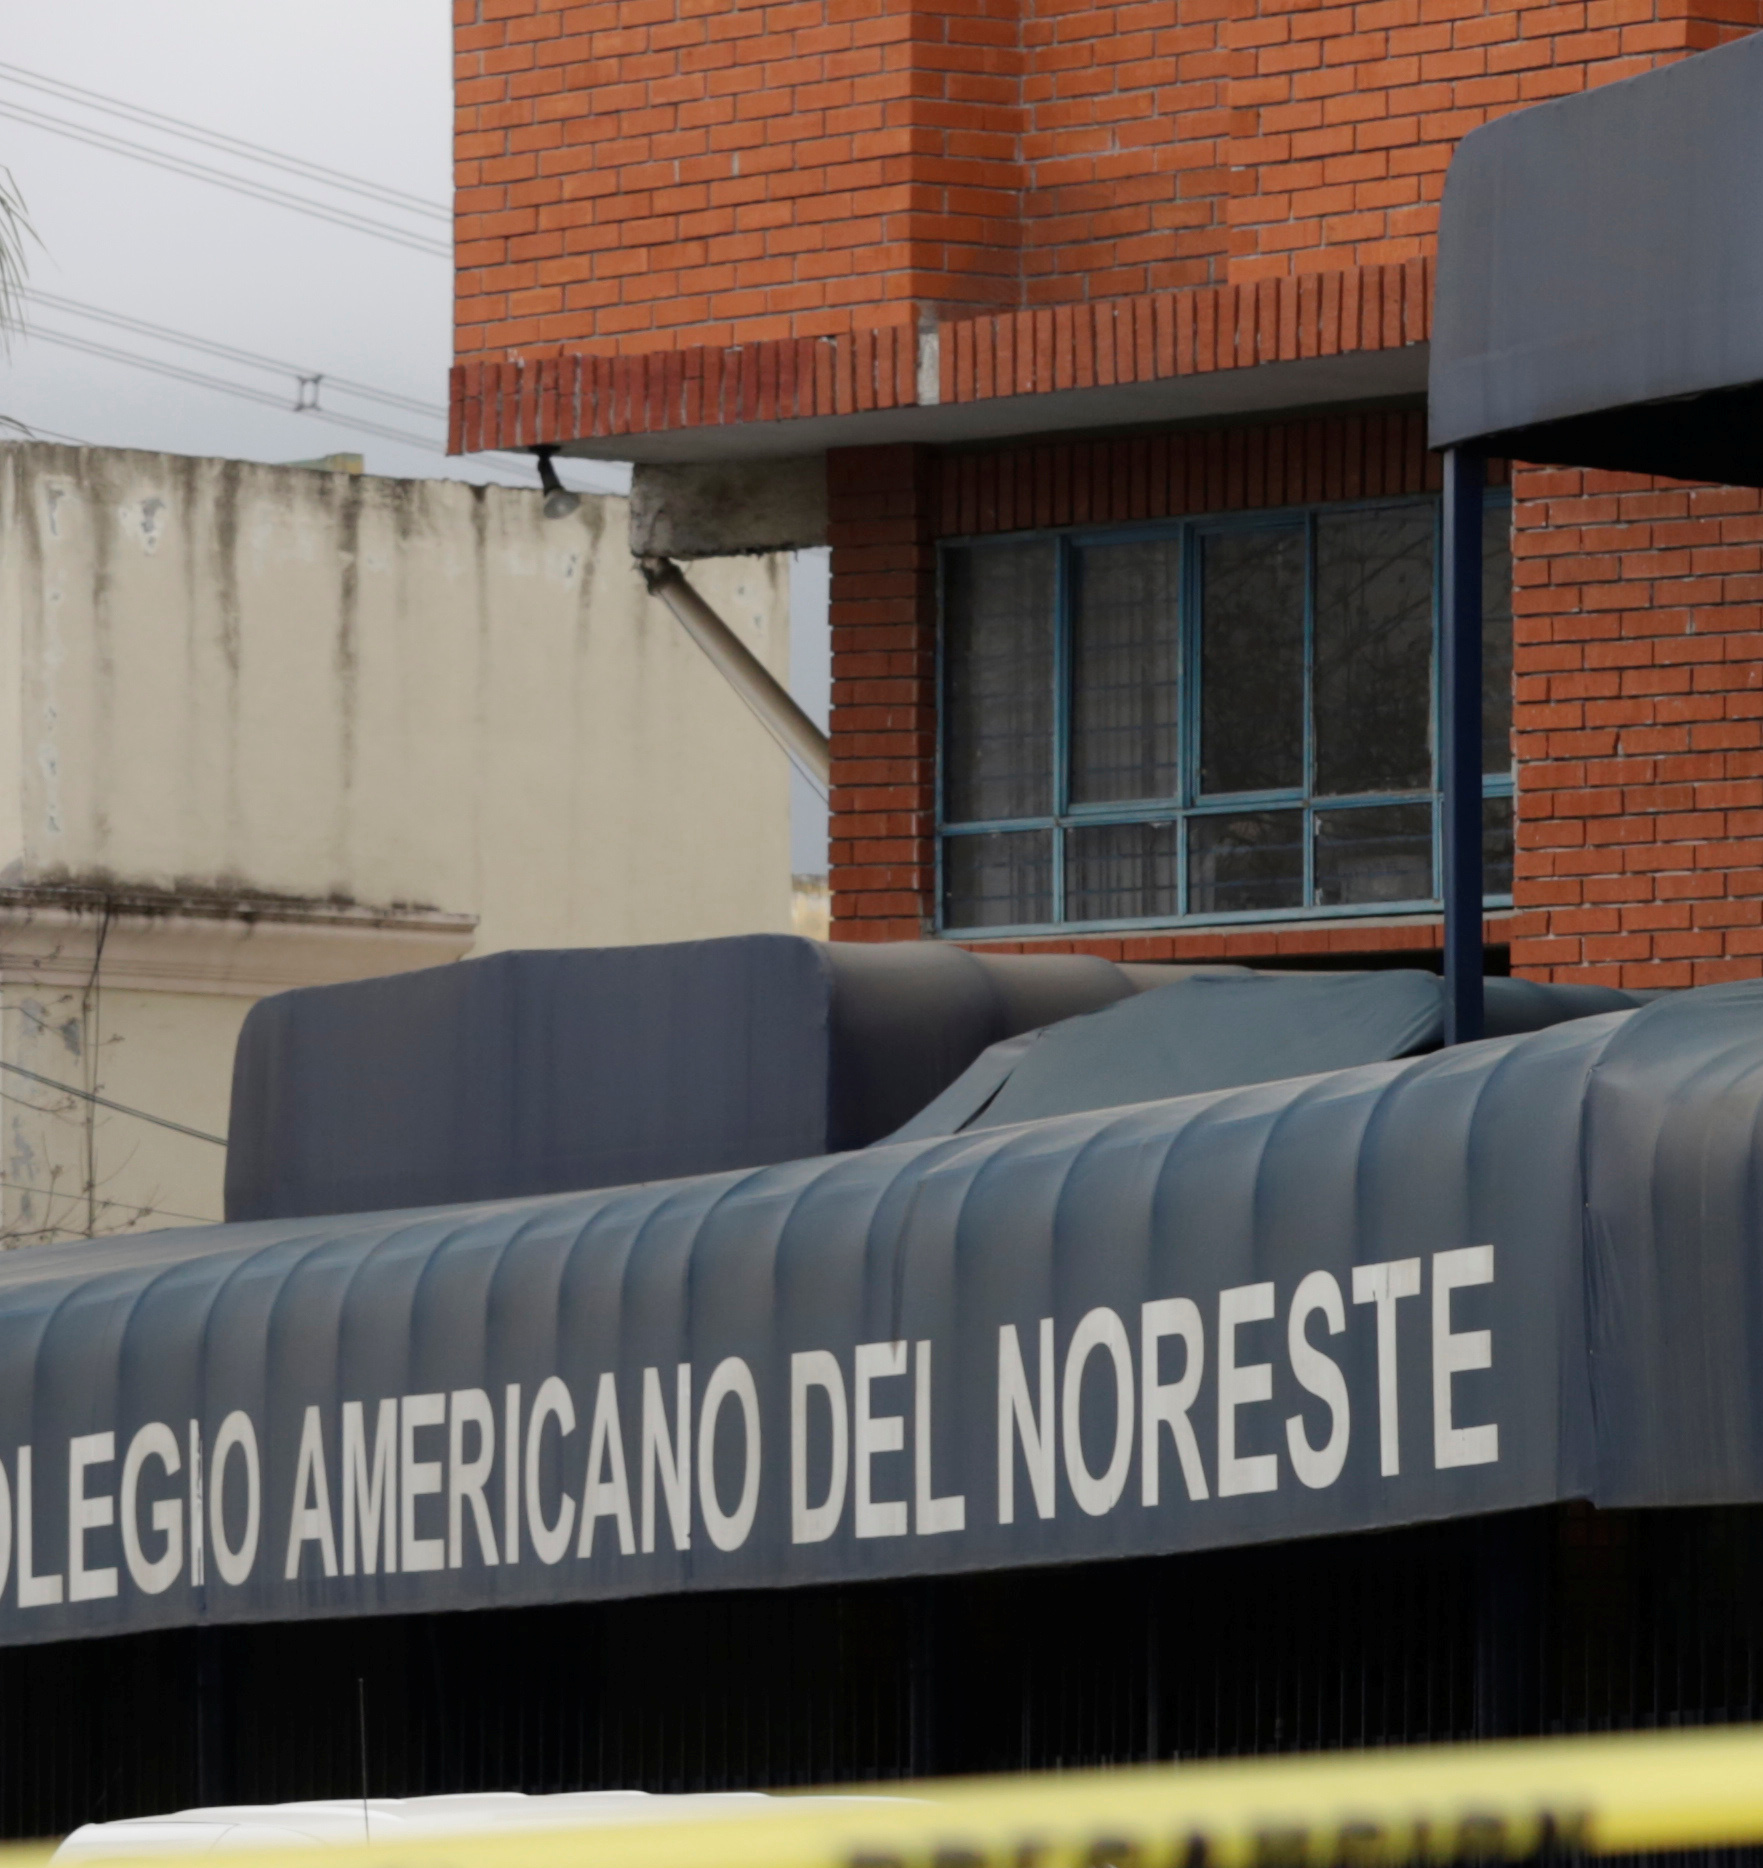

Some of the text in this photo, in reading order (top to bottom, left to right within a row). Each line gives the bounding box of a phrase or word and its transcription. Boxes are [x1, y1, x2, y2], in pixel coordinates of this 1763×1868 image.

[0, 1244, 1499, 1608] LEGIO AMERICANO DEL NORESTE
